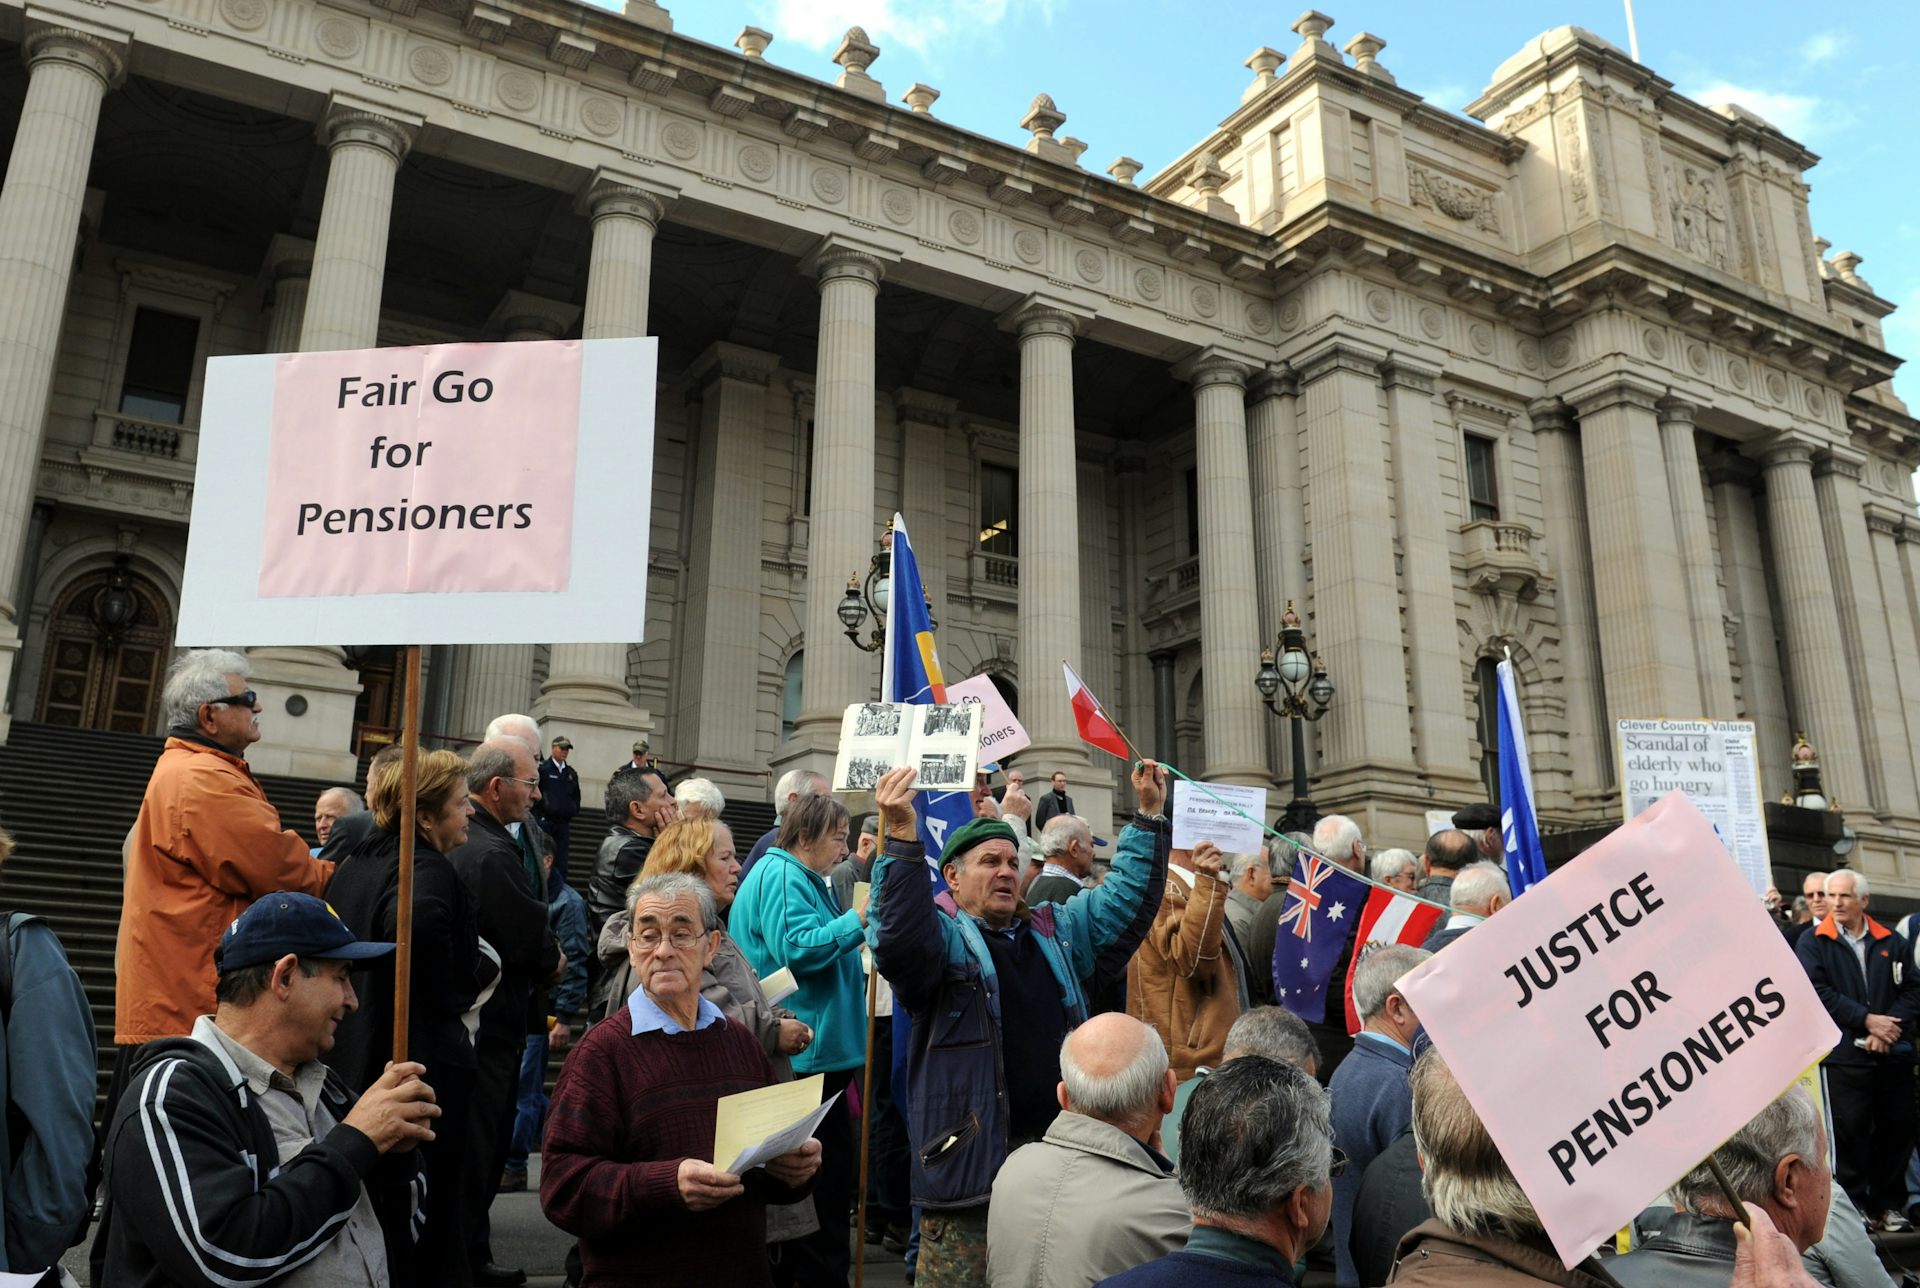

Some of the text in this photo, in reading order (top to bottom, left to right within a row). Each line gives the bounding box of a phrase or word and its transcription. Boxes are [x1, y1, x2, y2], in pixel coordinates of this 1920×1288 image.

[338, 370, 494, 409] Fair Go
[370, 435, 432, 469] for
[296, 498, 533, 536] Pensioners
[962, 696, 982, 704] Go
[980, 725, 1016, 750] ioners
[1620, 720, 1753, 733] Clever Country Values
[1626, 735, 1711, 752] Scandal of
[1628, 755, 1722, 776] elderly who
[1630, 775, 1713, 797] go hungry
[1503, 871, 1665, 1009] JUSTICE
[1585, 970, 1673, 1050] FOR
[1547, 976, 1786, 1186] PENSIONERS
